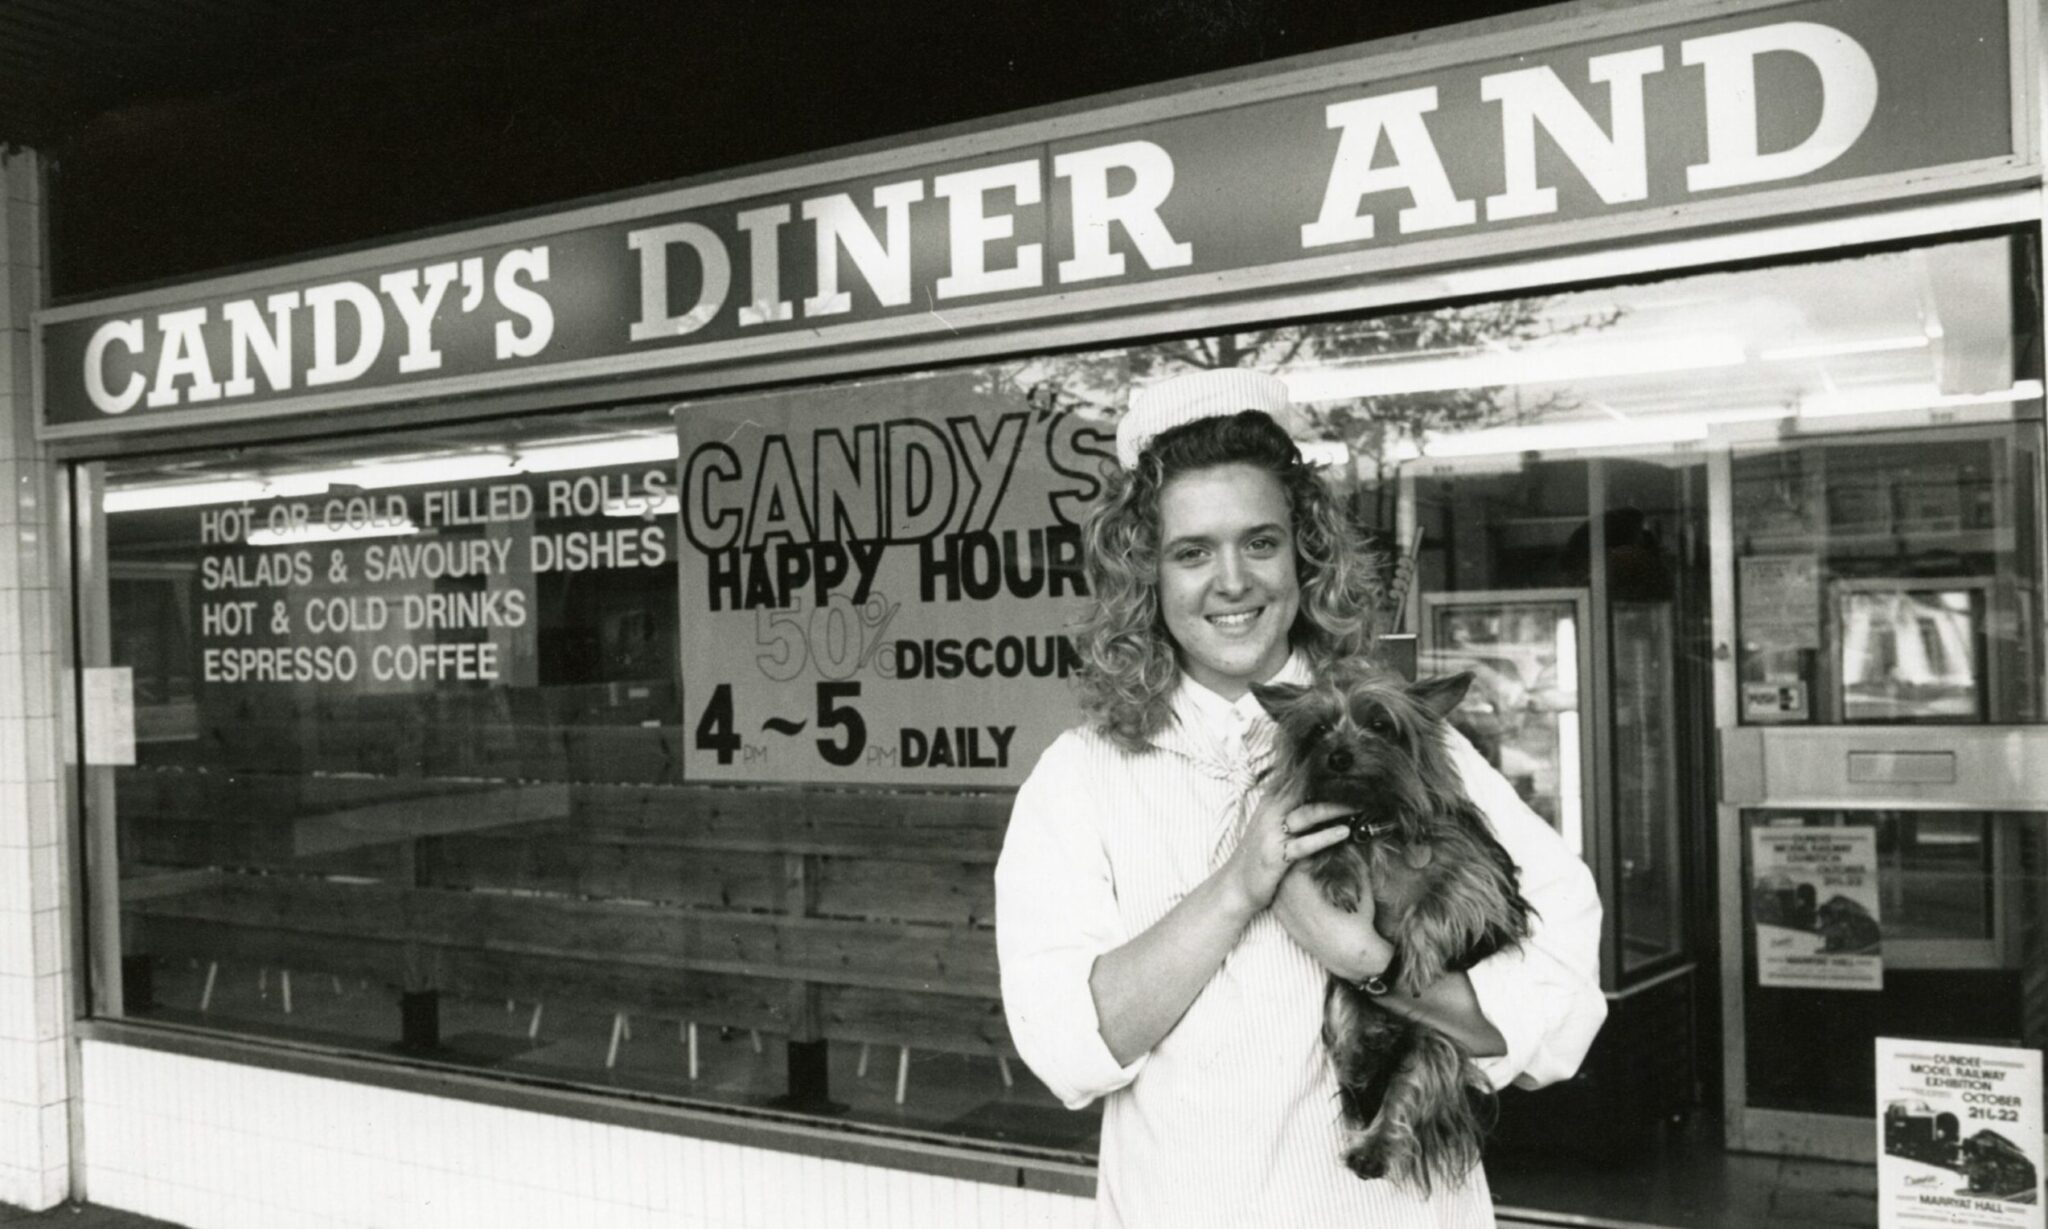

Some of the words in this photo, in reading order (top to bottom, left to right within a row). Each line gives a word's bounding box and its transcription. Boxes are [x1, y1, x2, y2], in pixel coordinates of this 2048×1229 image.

[84, 246, 554, 414] CANDY'S
[628, 140, 1193, 341] DINER
[1301, 21, 1879, 249] AND
[682, 383, 1117, 554] CANDY'S
[202, 501, 256, 544] HOT
[269, 499, 309, 536] OR
[323, 496, 408, 530] COLD
[424, 484, 533, 526] FILLED
[548, 469, 669, 518] ROLLS
[202, 550, 313, 591] SALADS
[328, 549, 348, 584] &
[364, 538, 512, 583] SAVOURY
[530, 526, 667, 573] DISHES
[707, 539, 885, 612] HAPPY
[919, 524, 1091, 603] HOUR
[203, 601, 257, 636] HOT
[271, 600, 290, 633] &
[305, 597, 388, 633] COLD
[404, 589, 527, 629] DRINKS
[754, 591, 900, 682] 50%
[895, 635, 1084, 681] DISCOUN
[204, 646, 358, 683] ESPRESSO
[371, 642, 500, 682] COFFEE
[695, 683, 742, 766] 4
[815, 681, 867, 767] 5
[900, 725, 1017, 768] DAILY
[1911, 1064, 1952, 1076] MODEL
[1956, 1067, 2006, 1081] RAILWAY
[1926, 1077, 1992, 1091] EXHIBITION
[1934, 1054, 1981, 1067] DUNDEE
[1962, 1092, 2022, 1106] OCTOBER
[1975, 1201, 2004, 1214] HALL
